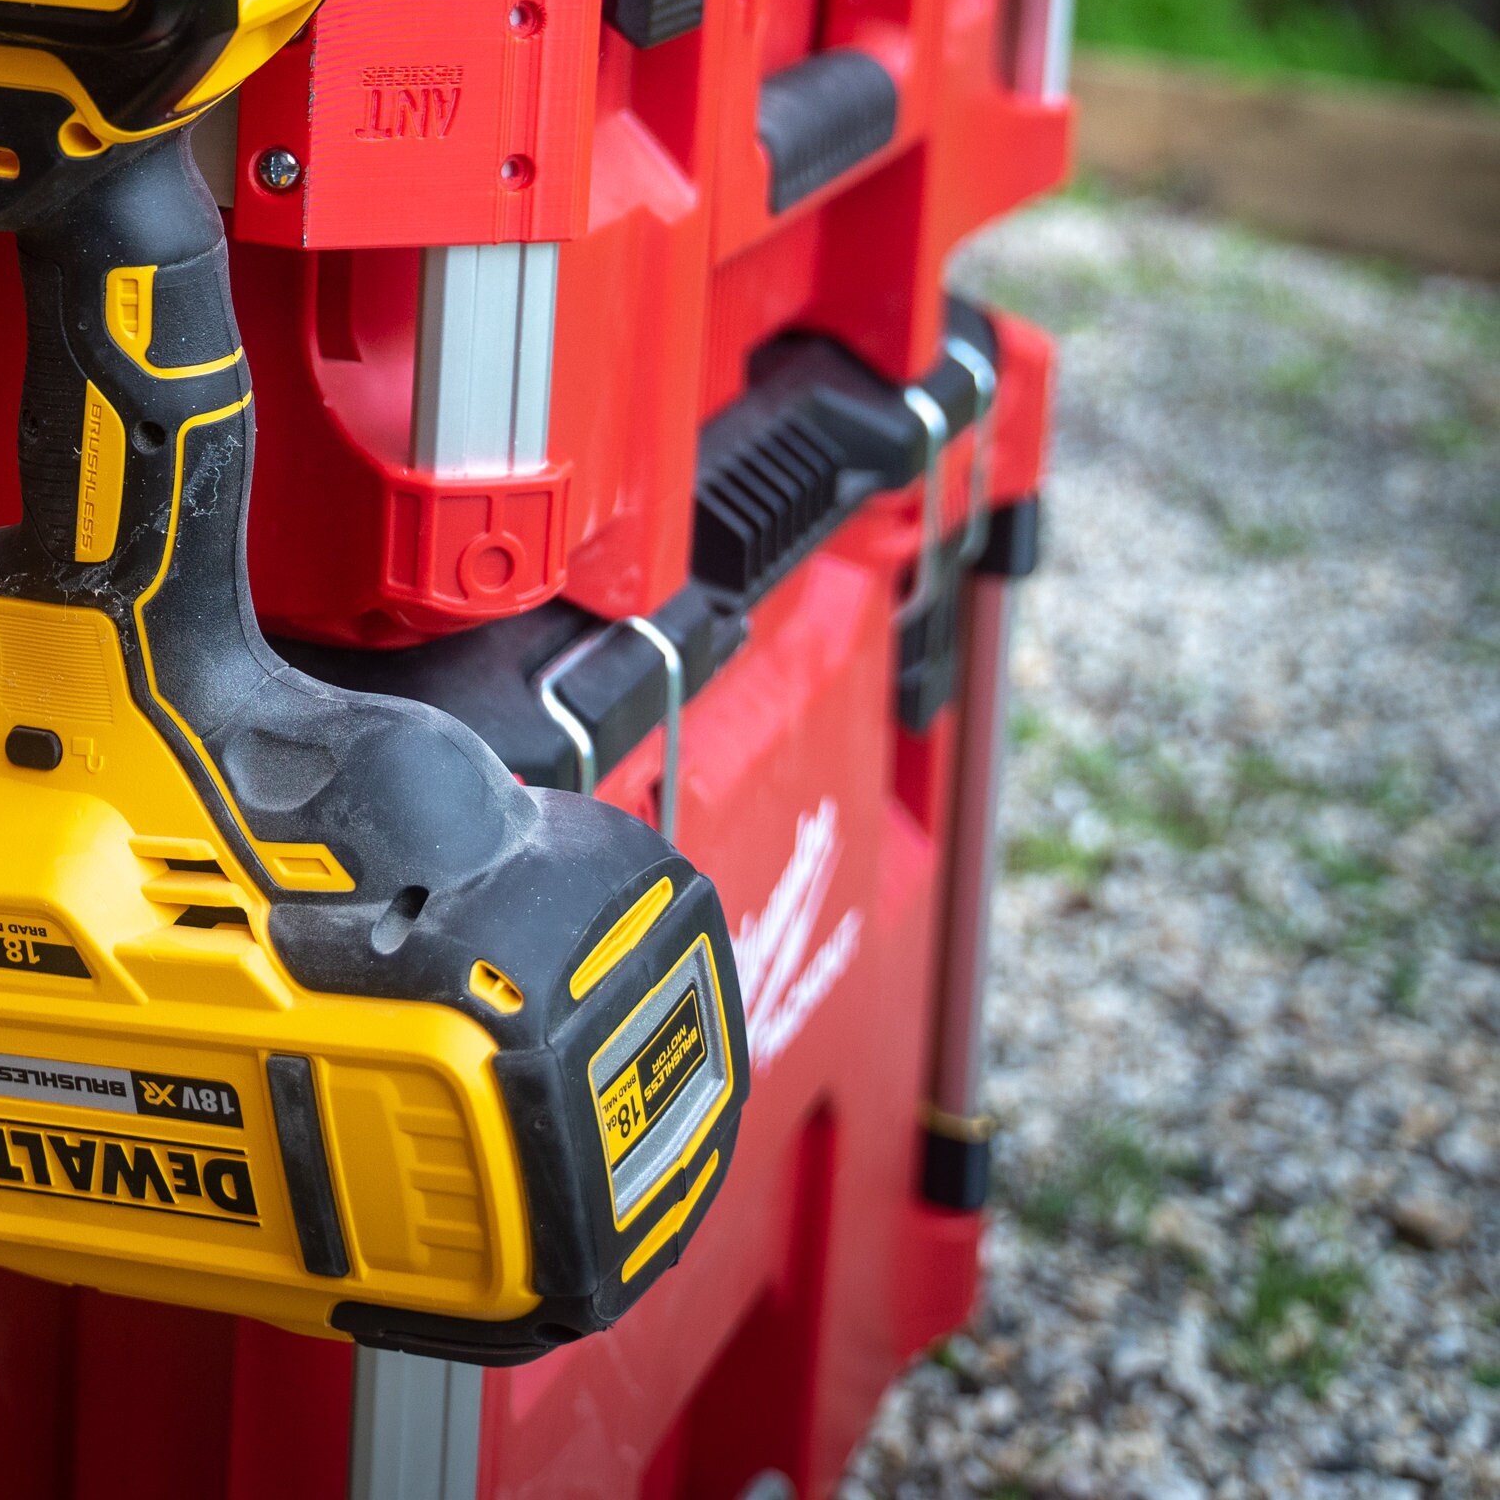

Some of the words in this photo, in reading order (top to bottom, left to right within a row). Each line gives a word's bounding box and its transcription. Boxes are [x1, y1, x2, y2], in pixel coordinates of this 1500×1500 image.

[355, 87, 462, 140] ANT
[82, 403, 102, 552] BRUSHLESS
[7, 923, 48, 938] BRAD
[3, 936, 40, 965] 18
[651, 1024, 688, 1075] MOTOR
[644, 1026, 699, 1103] BRUSHLESS
[139, 1079, 177, 1108] XR
[618, 1073, 637, 1098] BRAD
[182, 1086, 236, 1116] 18V
[602, 1094, 618, 1114] NAIL
[605, 1114, 618, 1132] GA
[618, 1094, 641, 1139] 18
